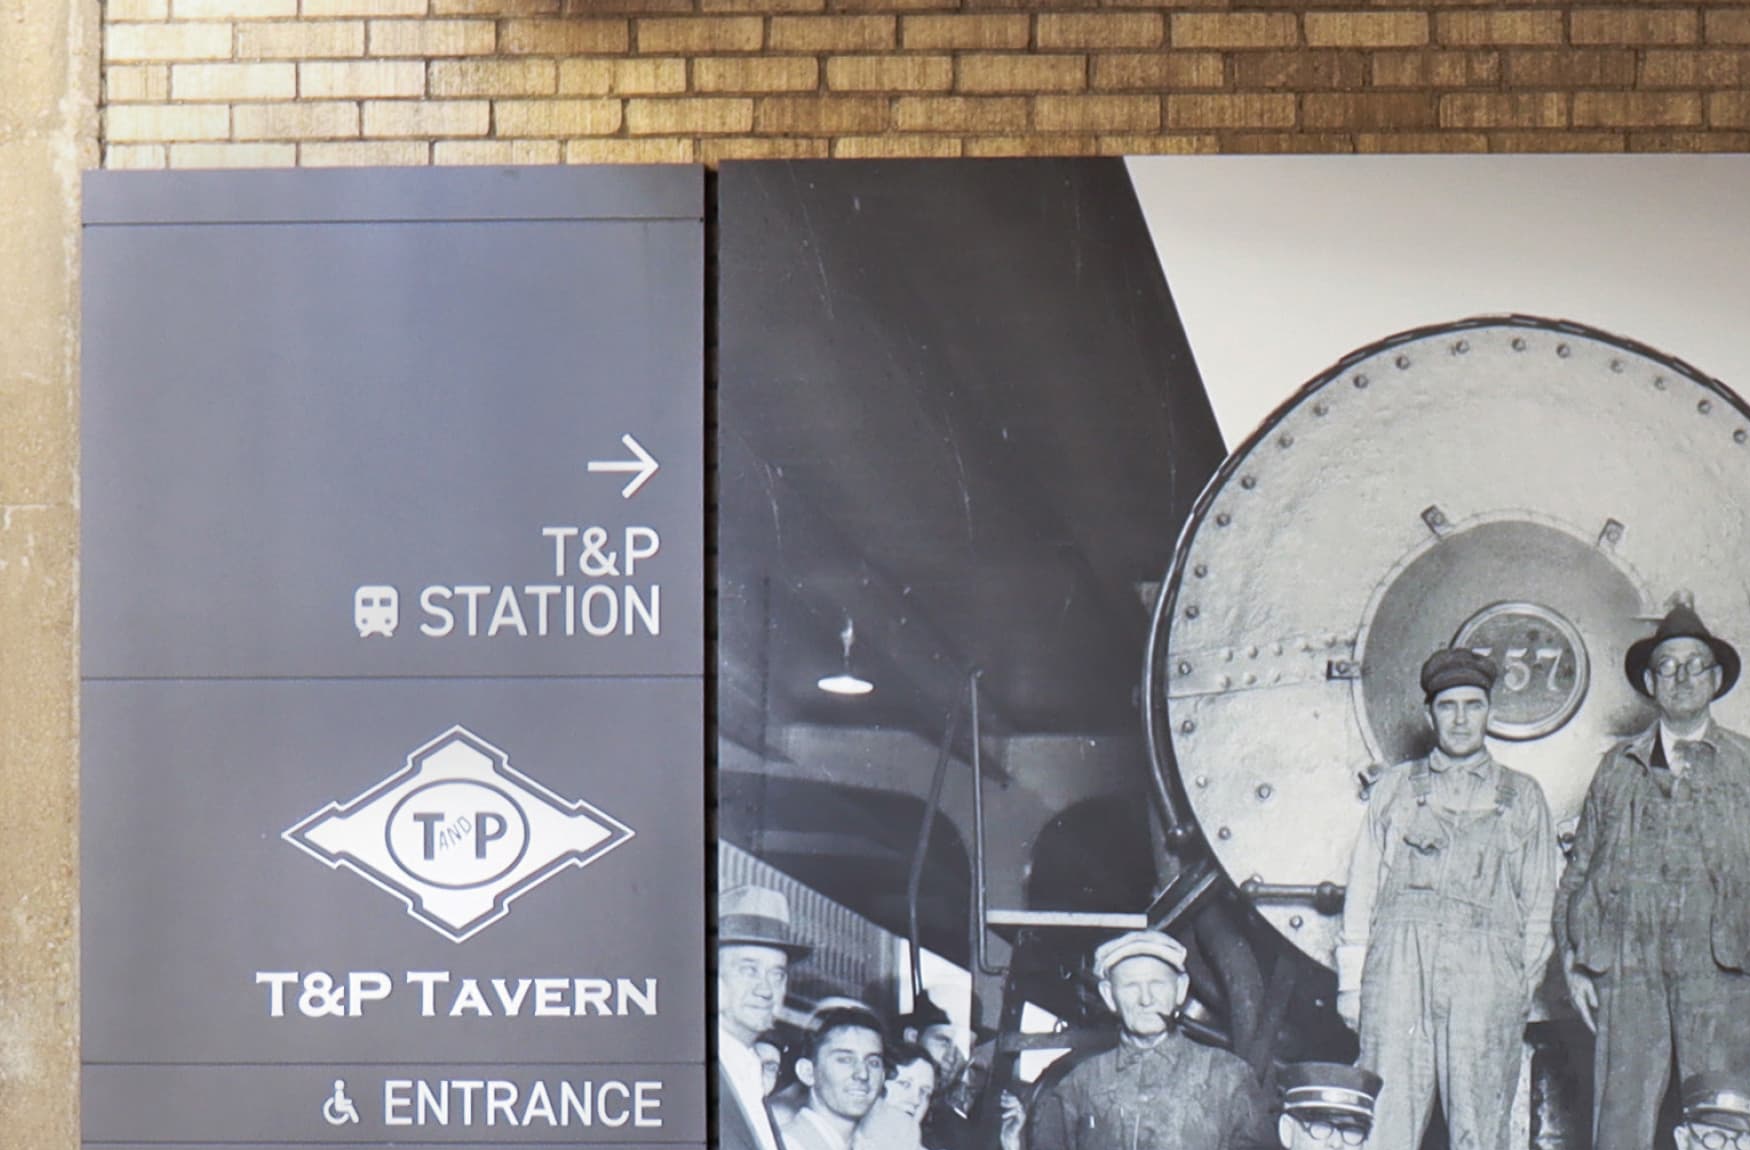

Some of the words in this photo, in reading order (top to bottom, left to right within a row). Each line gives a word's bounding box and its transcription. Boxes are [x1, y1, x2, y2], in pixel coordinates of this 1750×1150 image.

[541, 526, 661, 577] T&P
[419, 585, 661, 637] STATION
[1471, 647, 1563, 692] 57
[413, 812, 444, 860] T
[439, 815, 473, 851] AND
[475, 811, 508, 859] P
[256, 970, 392, 1017] T&P
[384, 1080, 663, 1127] ENTRANCE
